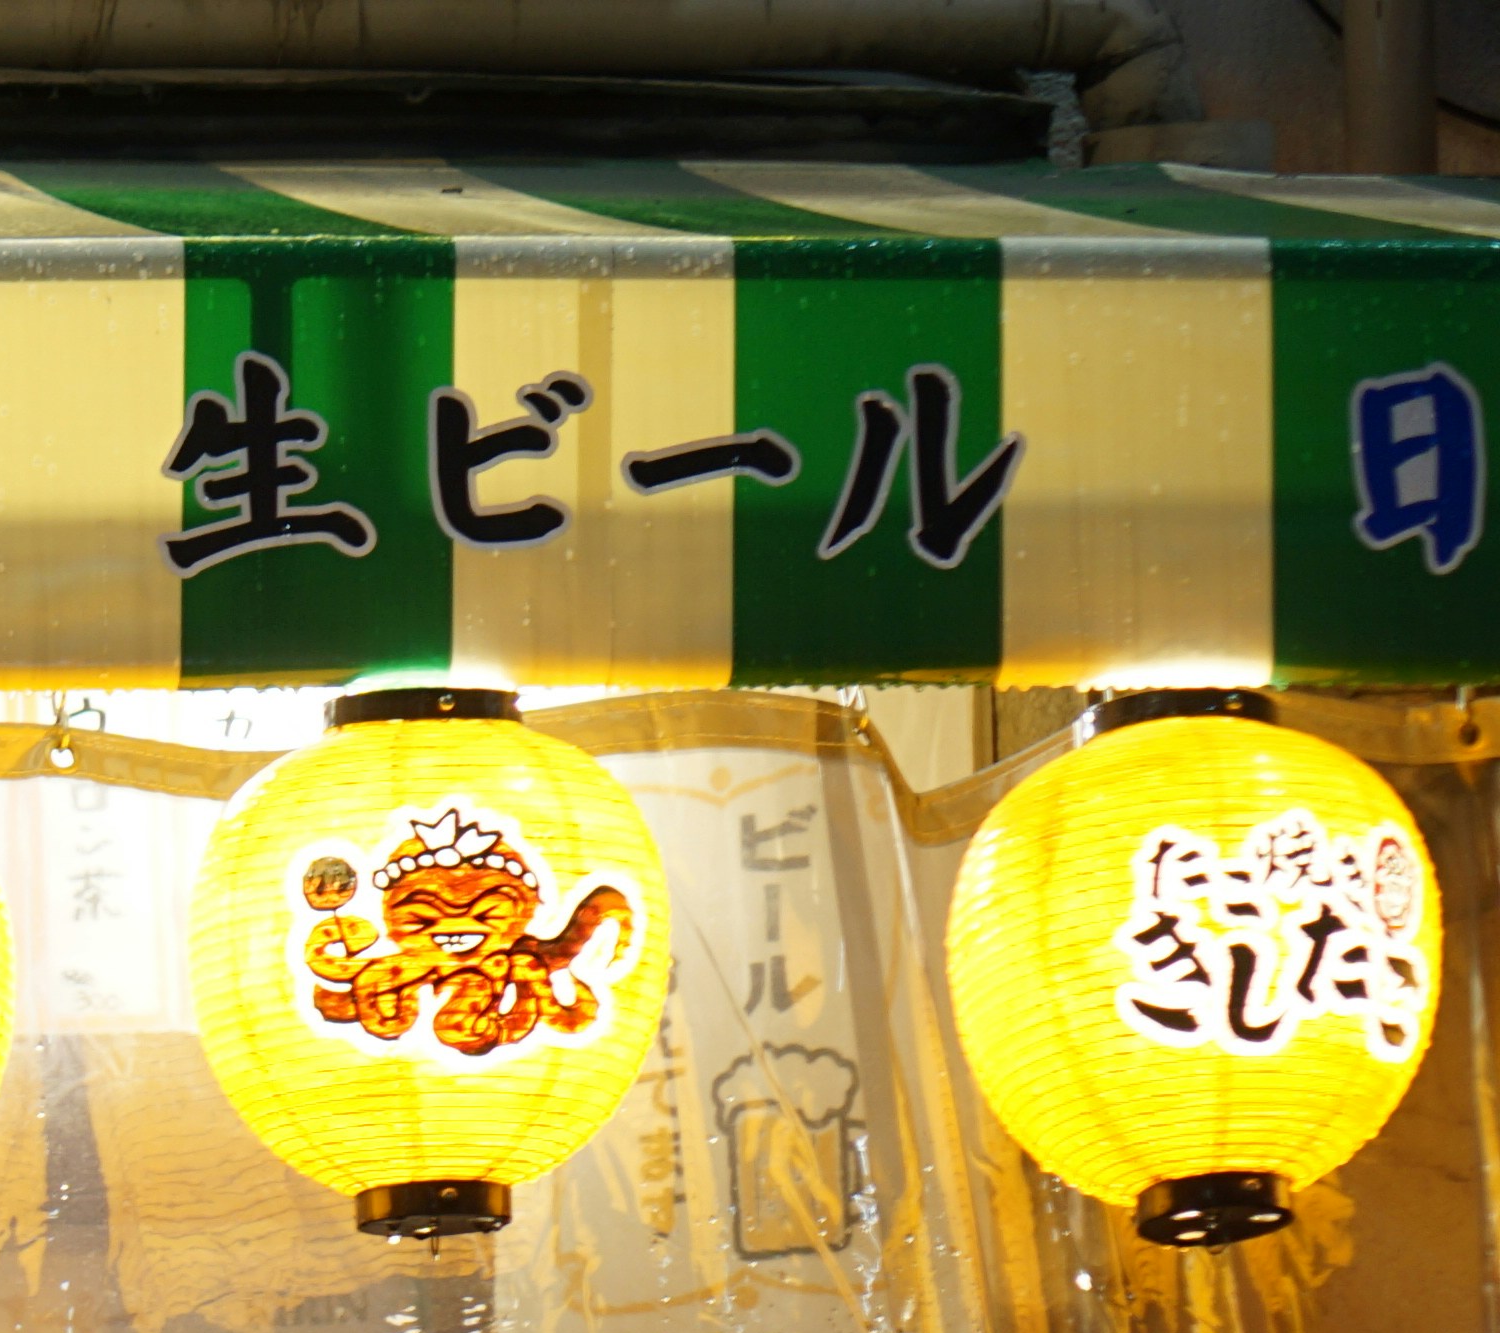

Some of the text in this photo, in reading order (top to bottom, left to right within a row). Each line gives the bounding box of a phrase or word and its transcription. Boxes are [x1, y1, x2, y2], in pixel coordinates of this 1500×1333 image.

[158, 352, 1026, 575] 生ビール
[738, 803, 822, 1017] ビール
[1131, 903, 1419, 1046] きしたこ
